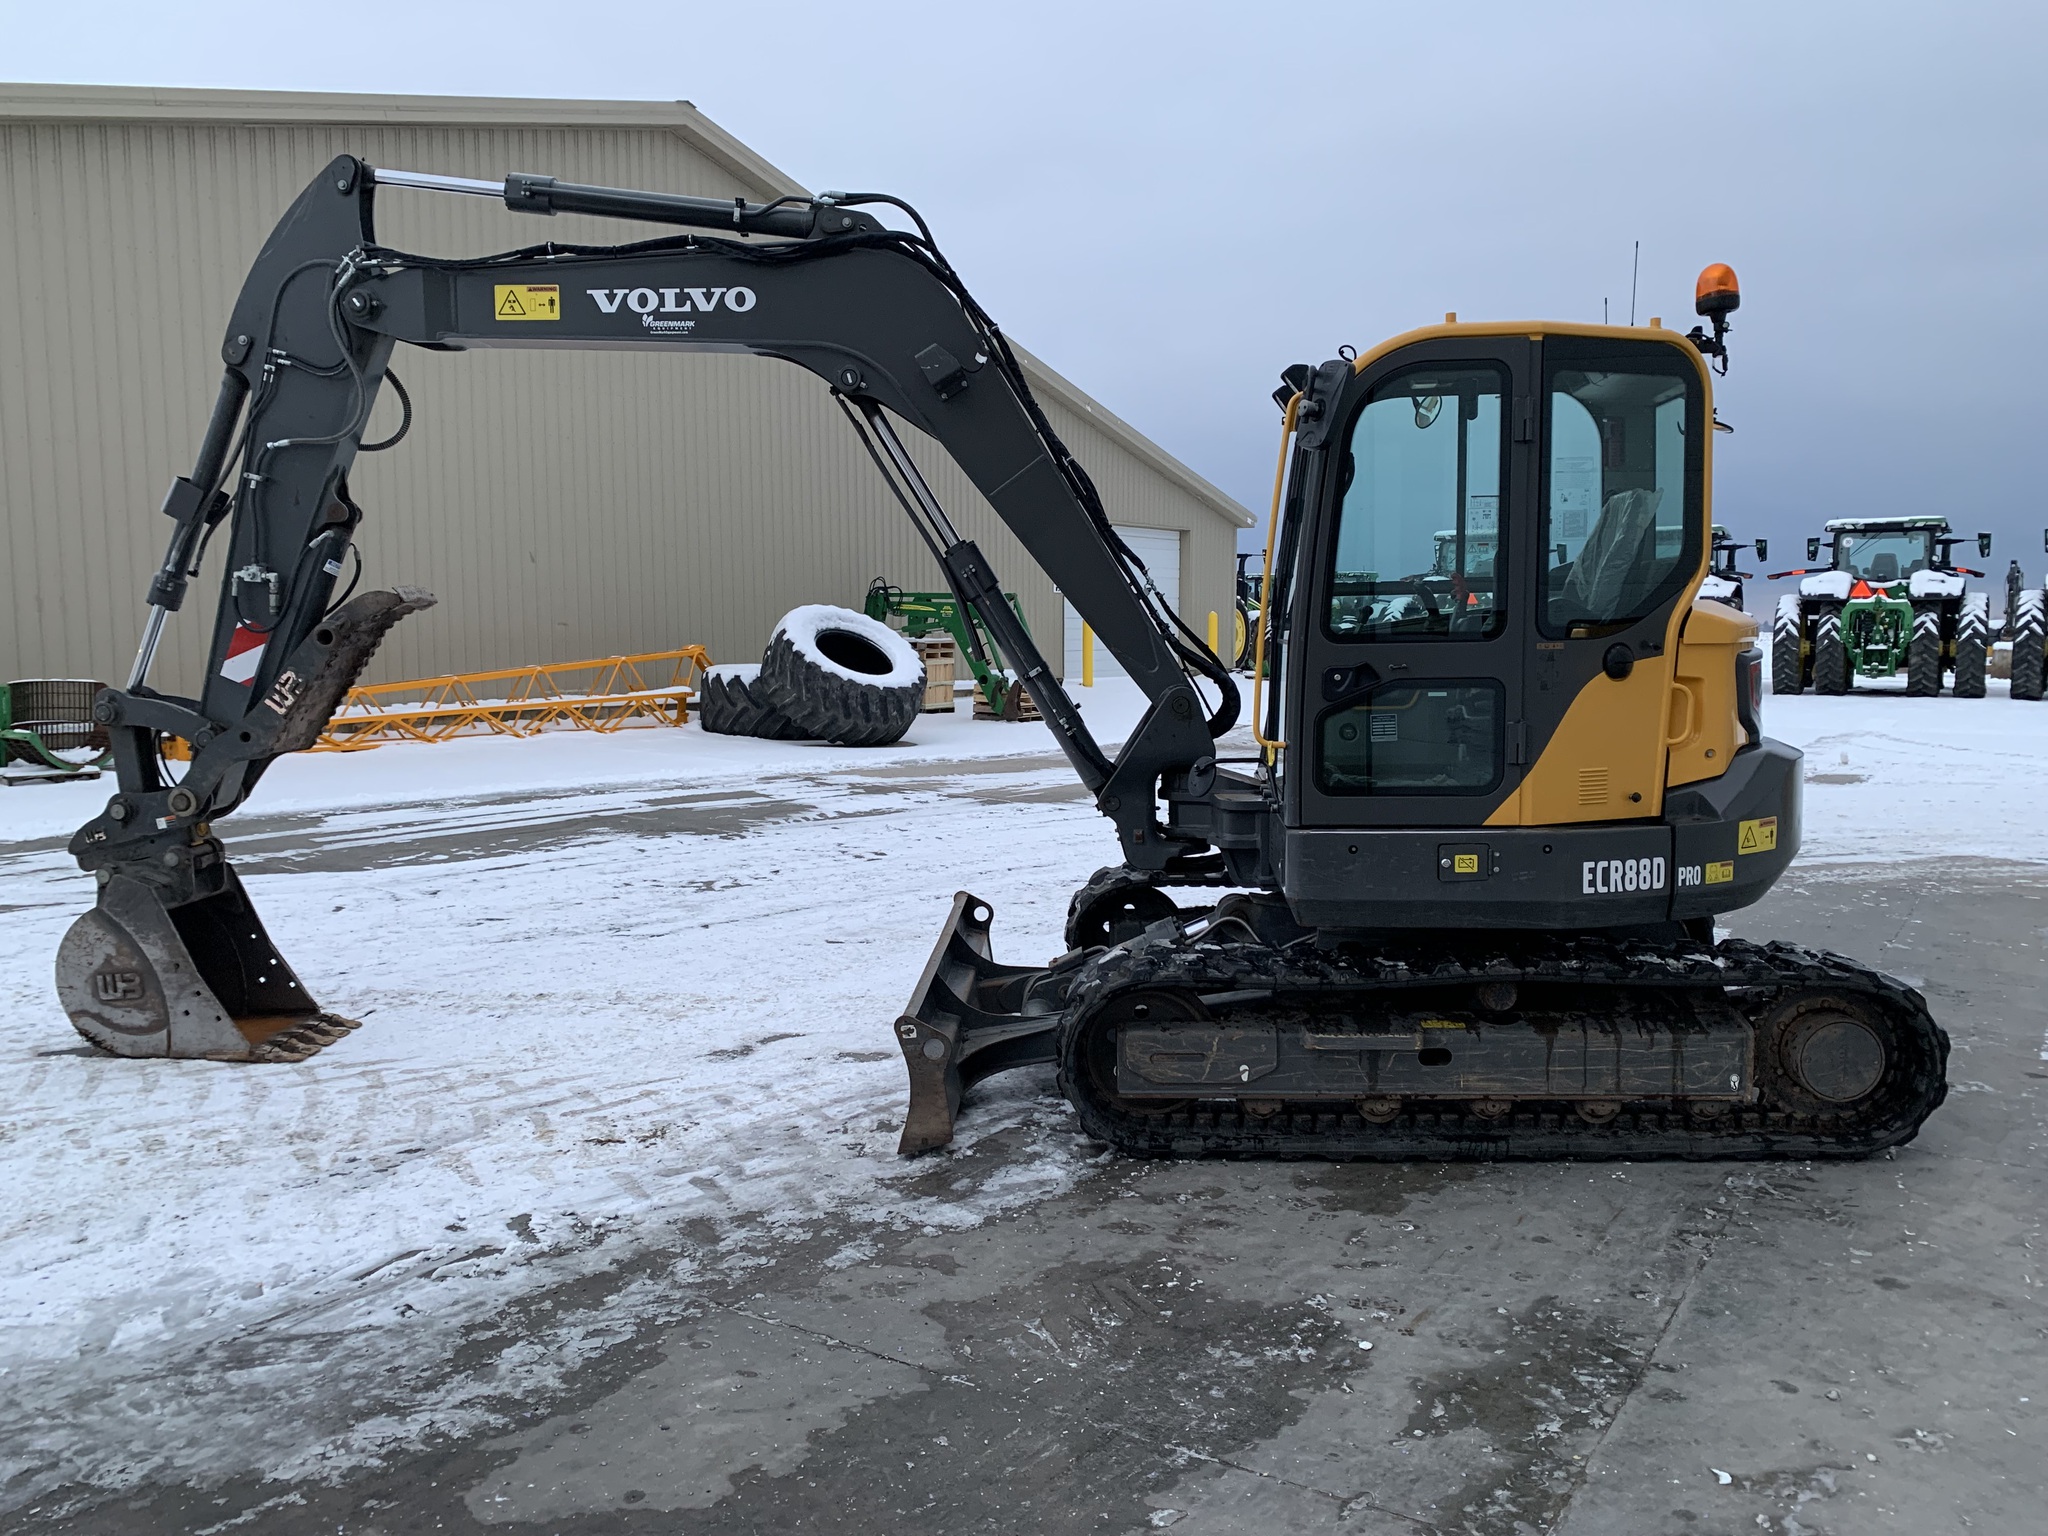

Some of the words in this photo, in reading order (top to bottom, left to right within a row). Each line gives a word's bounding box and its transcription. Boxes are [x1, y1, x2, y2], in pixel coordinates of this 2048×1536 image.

[587, 286, 757, 313] VOLVO
[1582, 856, 1666, 894] ECR88D
[1678, 865, 1702, 887] PRO
